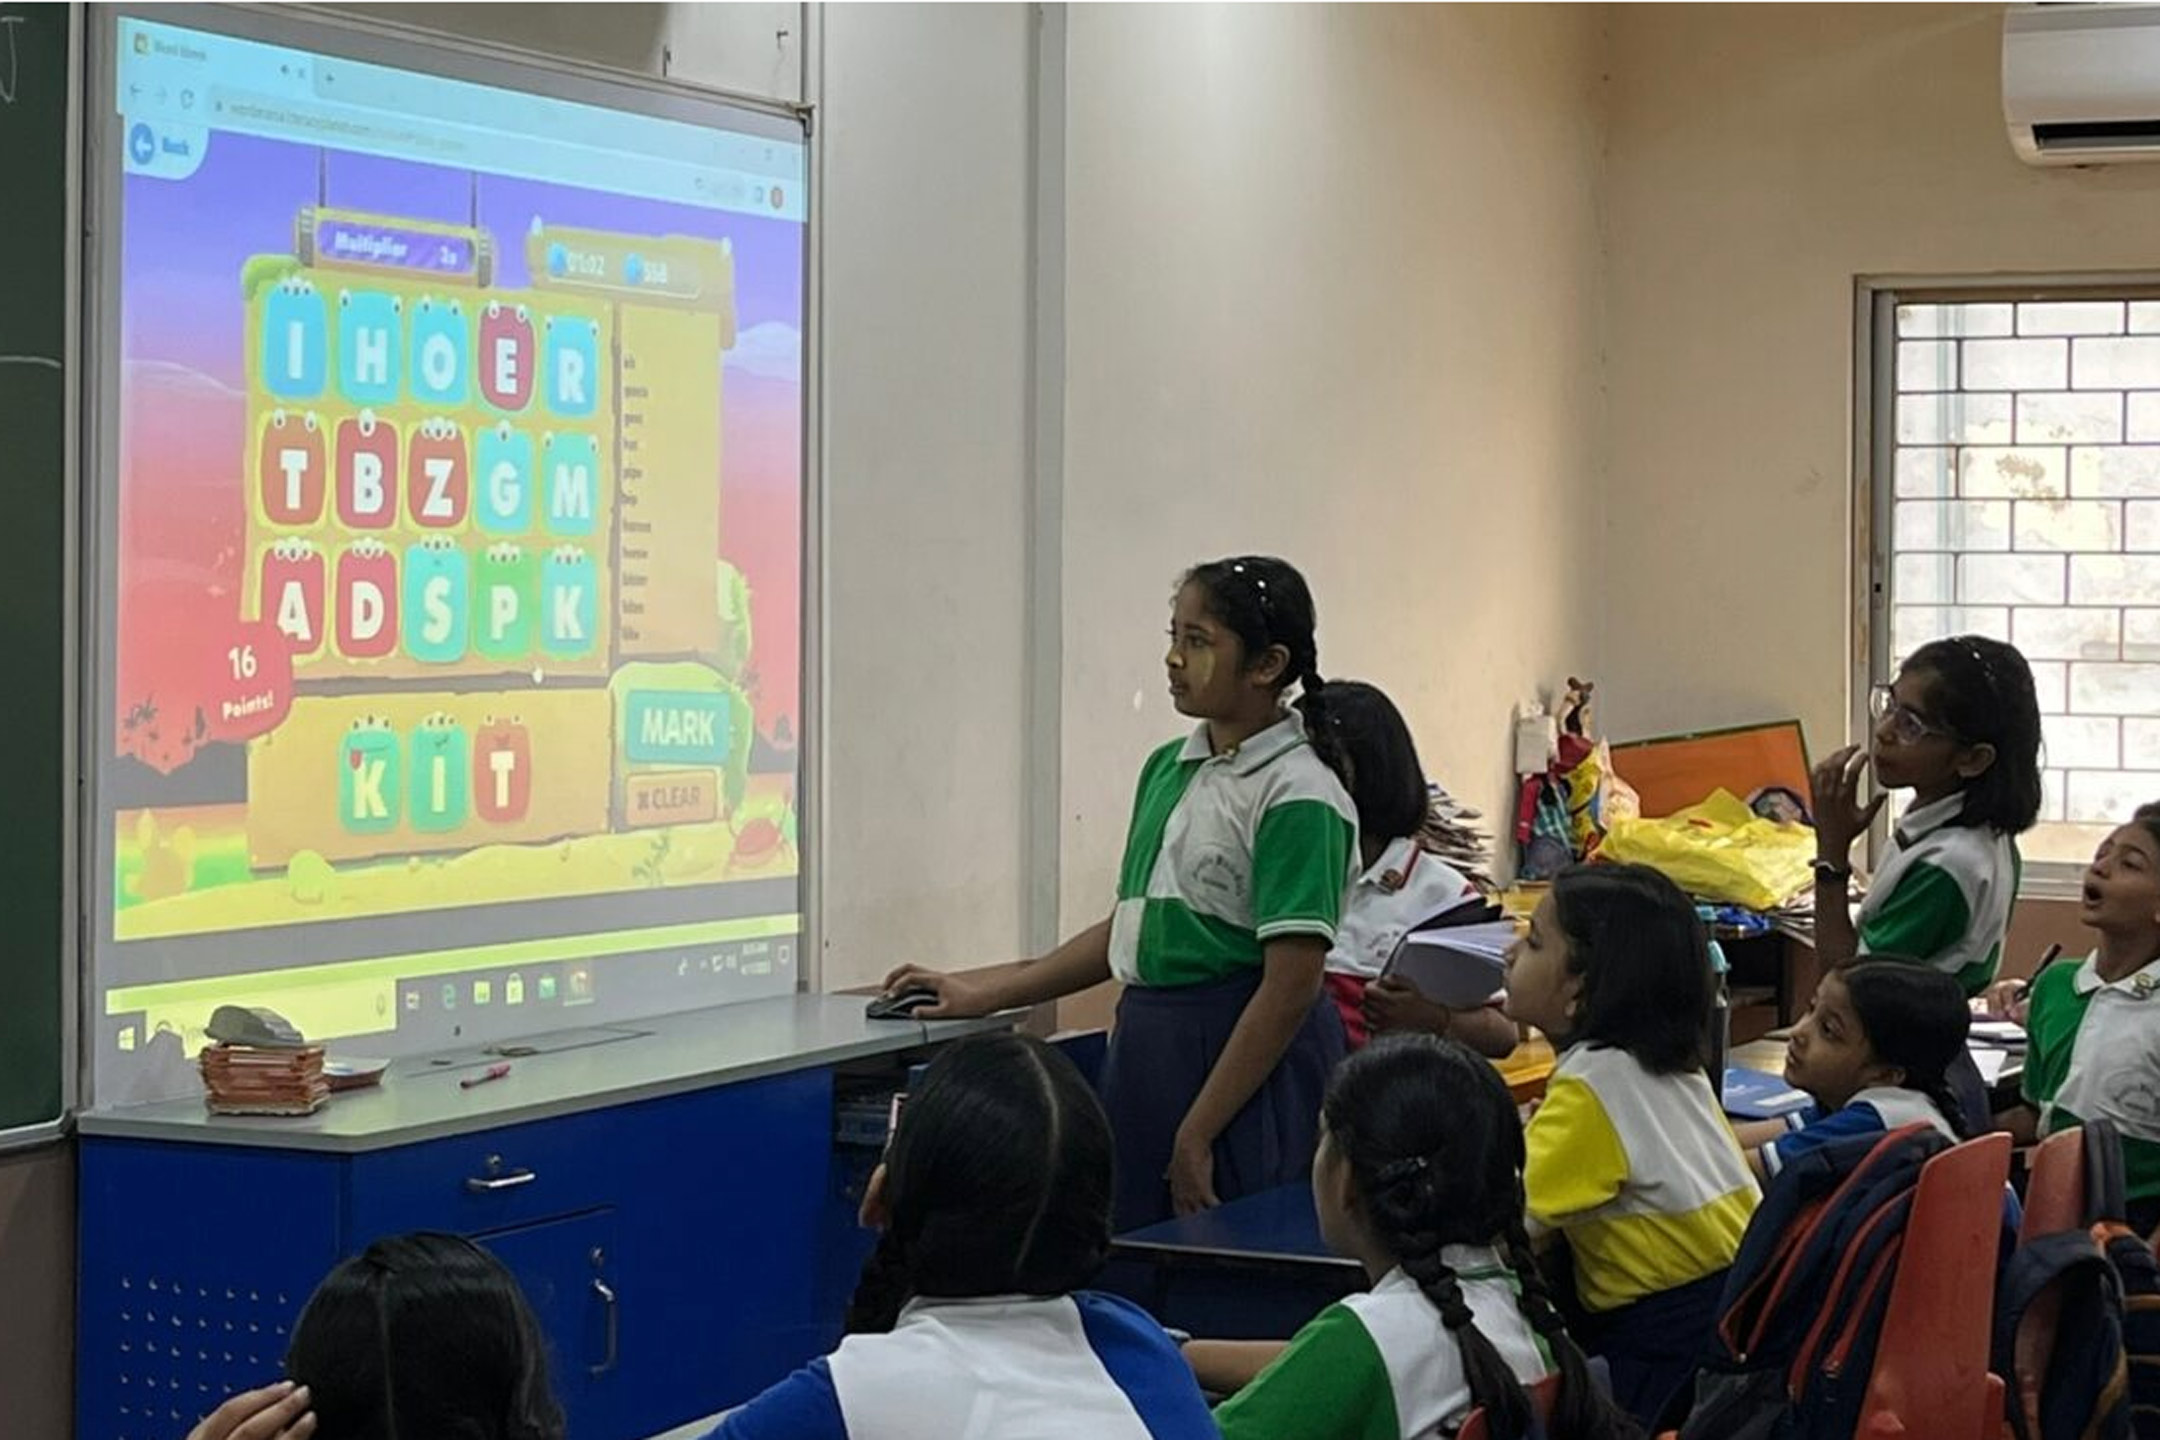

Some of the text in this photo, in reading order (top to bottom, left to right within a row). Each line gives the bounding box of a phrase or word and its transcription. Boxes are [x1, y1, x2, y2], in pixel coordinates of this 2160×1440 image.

[335, 231, 408, 259] Multiplier
[288, 321, 585, 404] I H O E R
[278, 448, 590, 518] T B Z G M
[277, 576, 584, 644] A D S P K
[228, 645, 257, 680] 16
[222, 689, 274, 720] Points!
[641, 708, 715, 746] MARK
[652, 785, 702, 809] CLEAR
